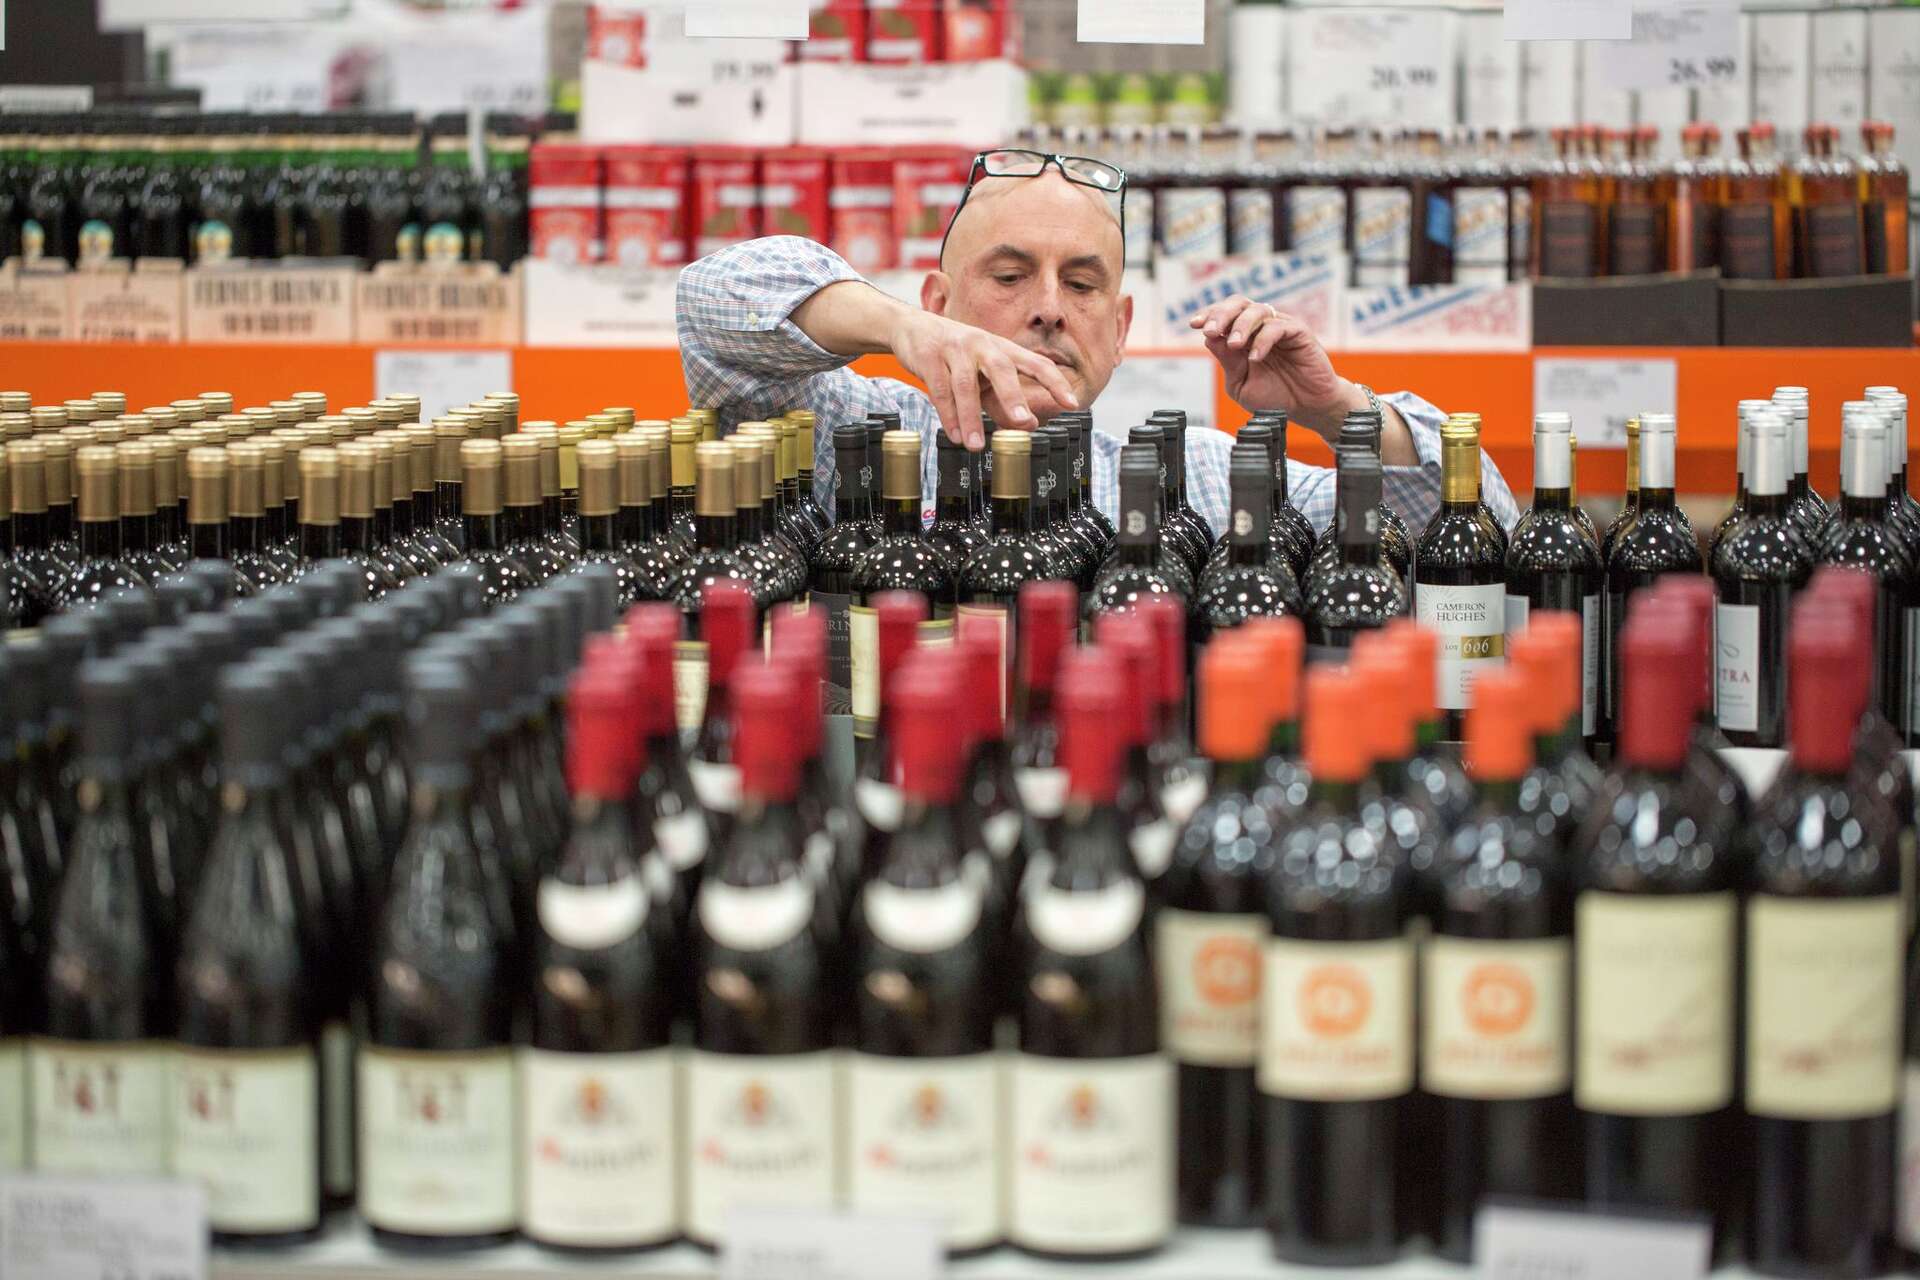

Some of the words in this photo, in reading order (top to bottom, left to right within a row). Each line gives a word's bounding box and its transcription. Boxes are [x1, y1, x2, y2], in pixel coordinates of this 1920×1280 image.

[1436, 602, 1486, 611] CAMERON
[1436, 612, 1486, 622] HUGHES
[1719, 668, 1751, 684] TRA
